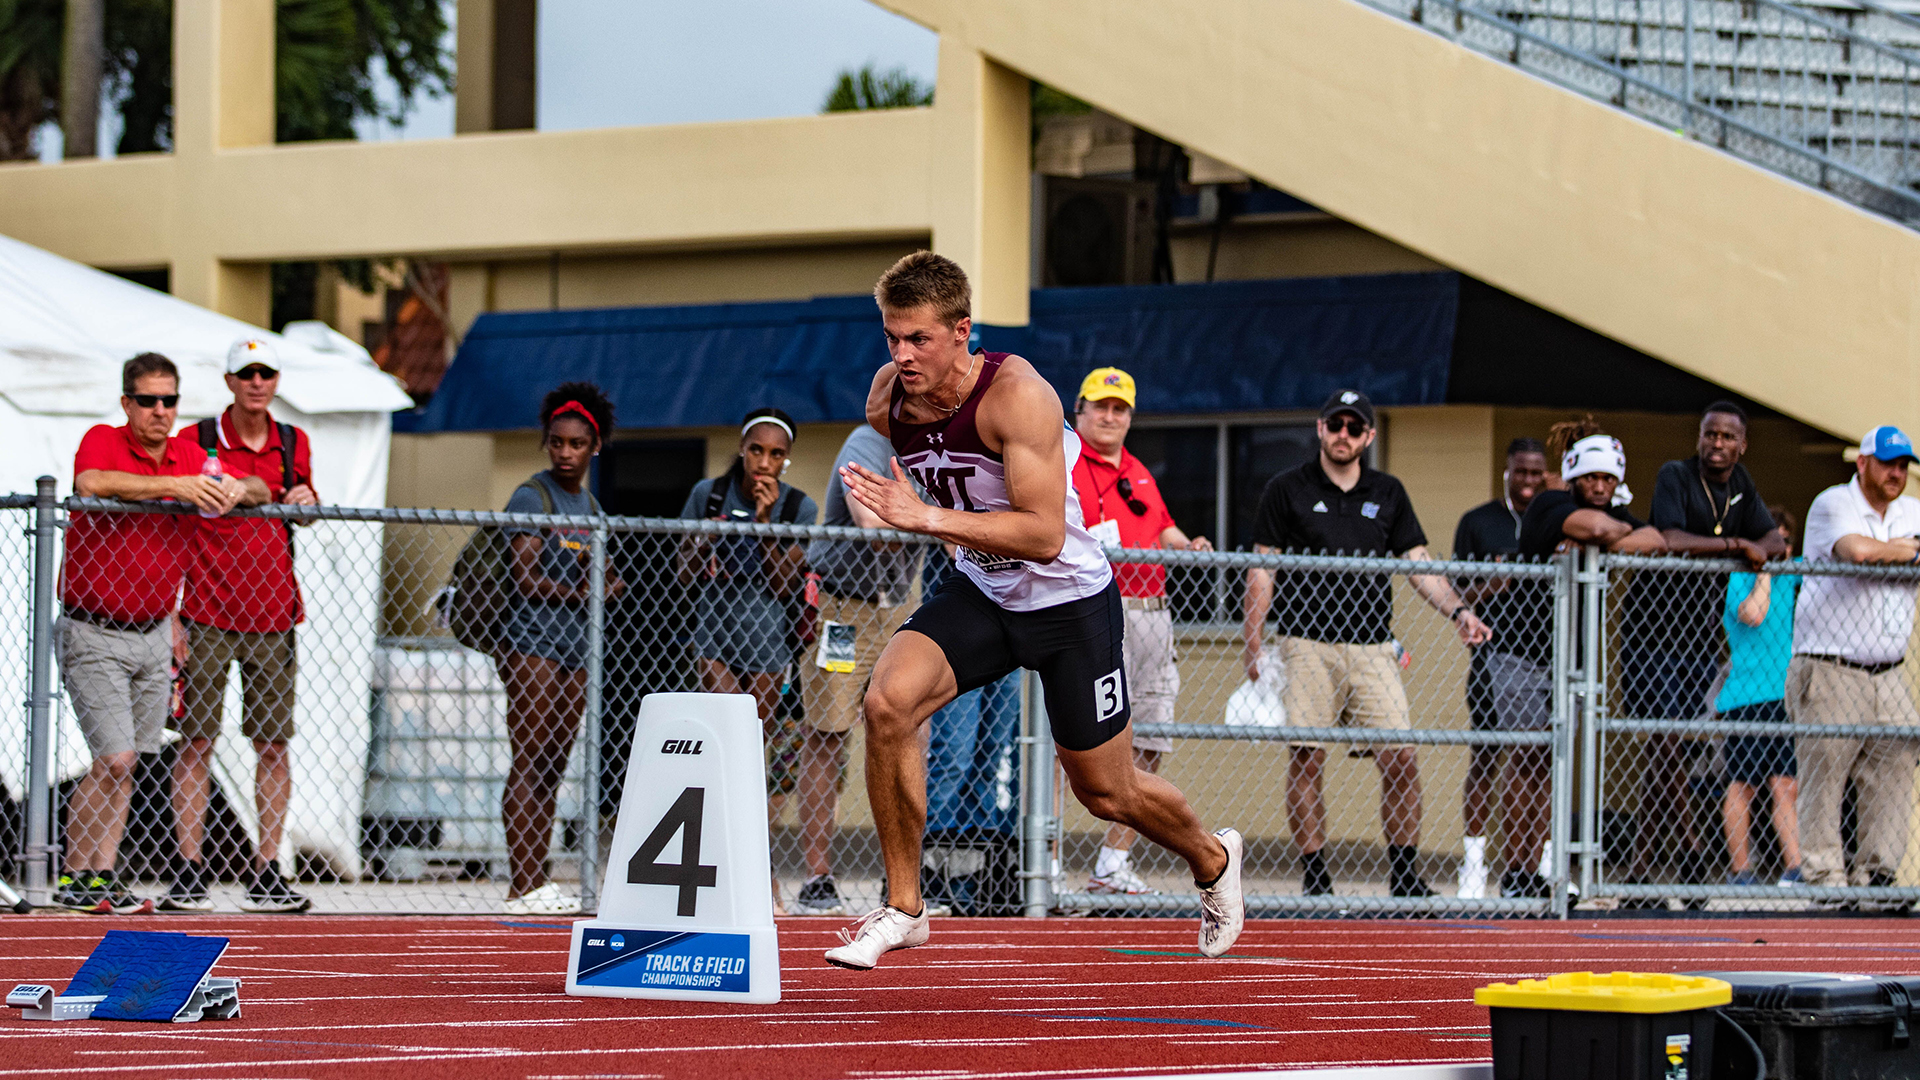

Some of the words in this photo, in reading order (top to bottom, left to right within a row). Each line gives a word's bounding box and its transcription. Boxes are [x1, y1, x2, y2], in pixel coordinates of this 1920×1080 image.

[1101, 676, 1118, 717] 3
[661, 739, 703, 755] GILL
[627, 786, 717, 917] 4
[587, 939, 605, 947] GILL
[645, 953, 690, 973] TRACK
[692, 956, 704, 973] &
[705, 957, 745, 975] FIELD
[641, 973, 722, 988] CHAMPIONSHIPS
[14, 985, 44, 993] GILL
